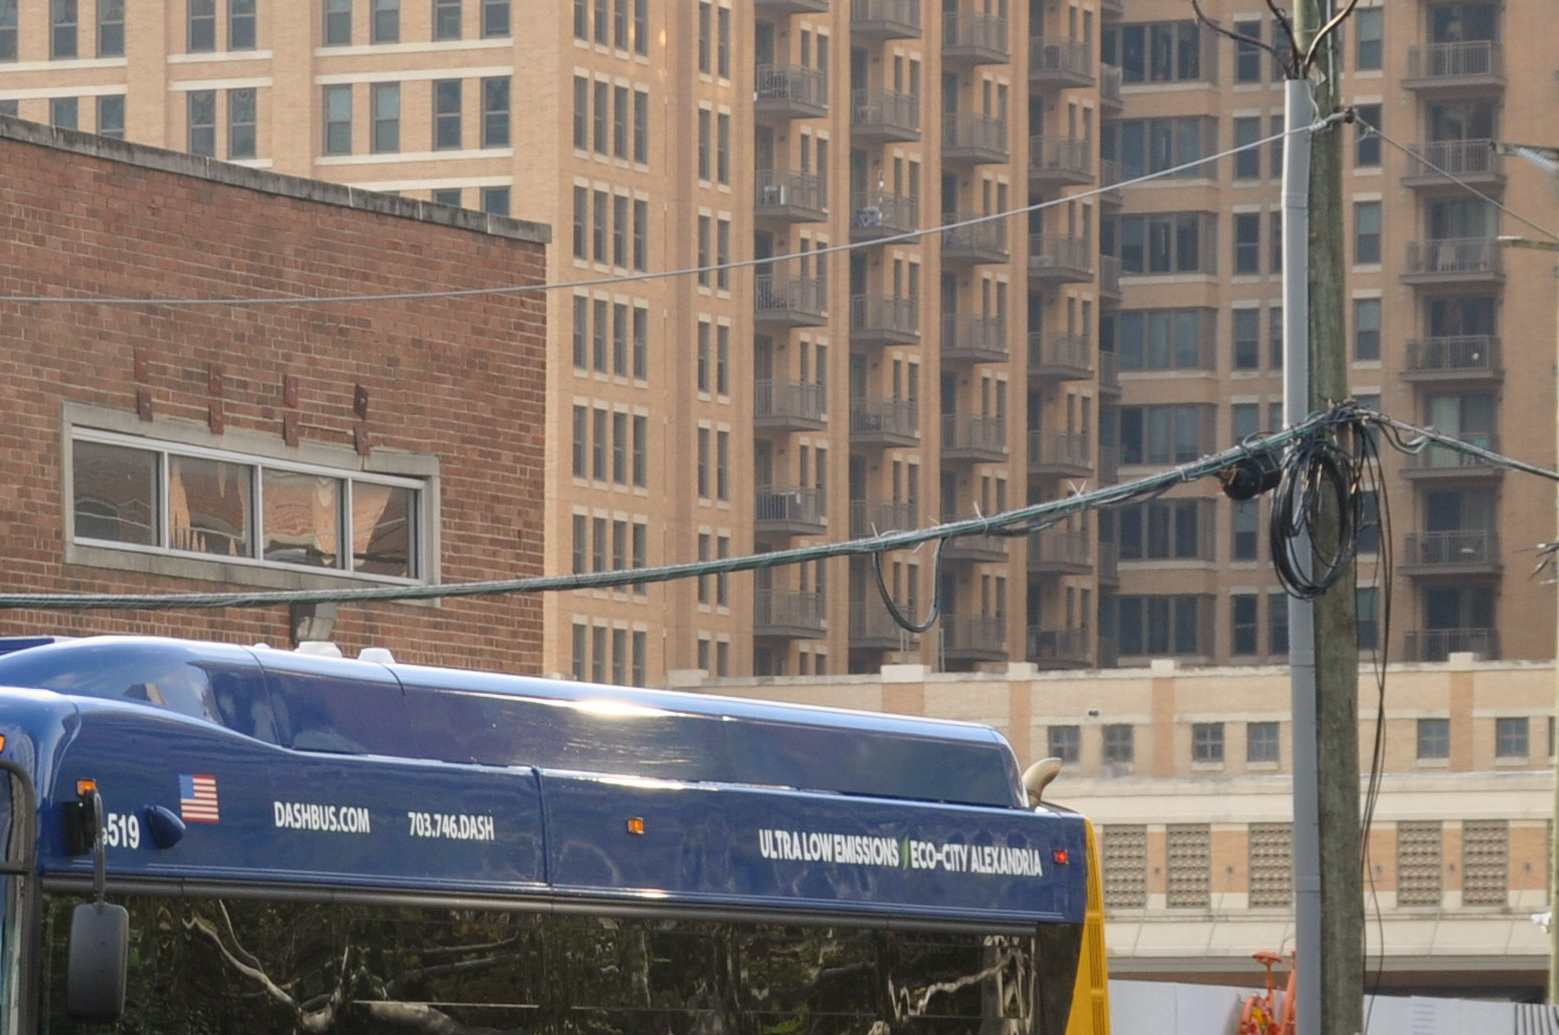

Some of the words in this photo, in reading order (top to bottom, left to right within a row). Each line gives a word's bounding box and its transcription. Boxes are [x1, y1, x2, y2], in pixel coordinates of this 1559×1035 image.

[274, 801, 370, 834] DASHBUS.COM
[408, 812, 495, 841] 703.746.DASH
[759, 829, 800, 860] ULTRA
[802, 832, 836, 863] LOW
[835, 834, 899, 867] EMISSIONS
[910, 839, 968, 872] ECO-CITY
[971, 845, 1042, 877] ALEXANDRIA
